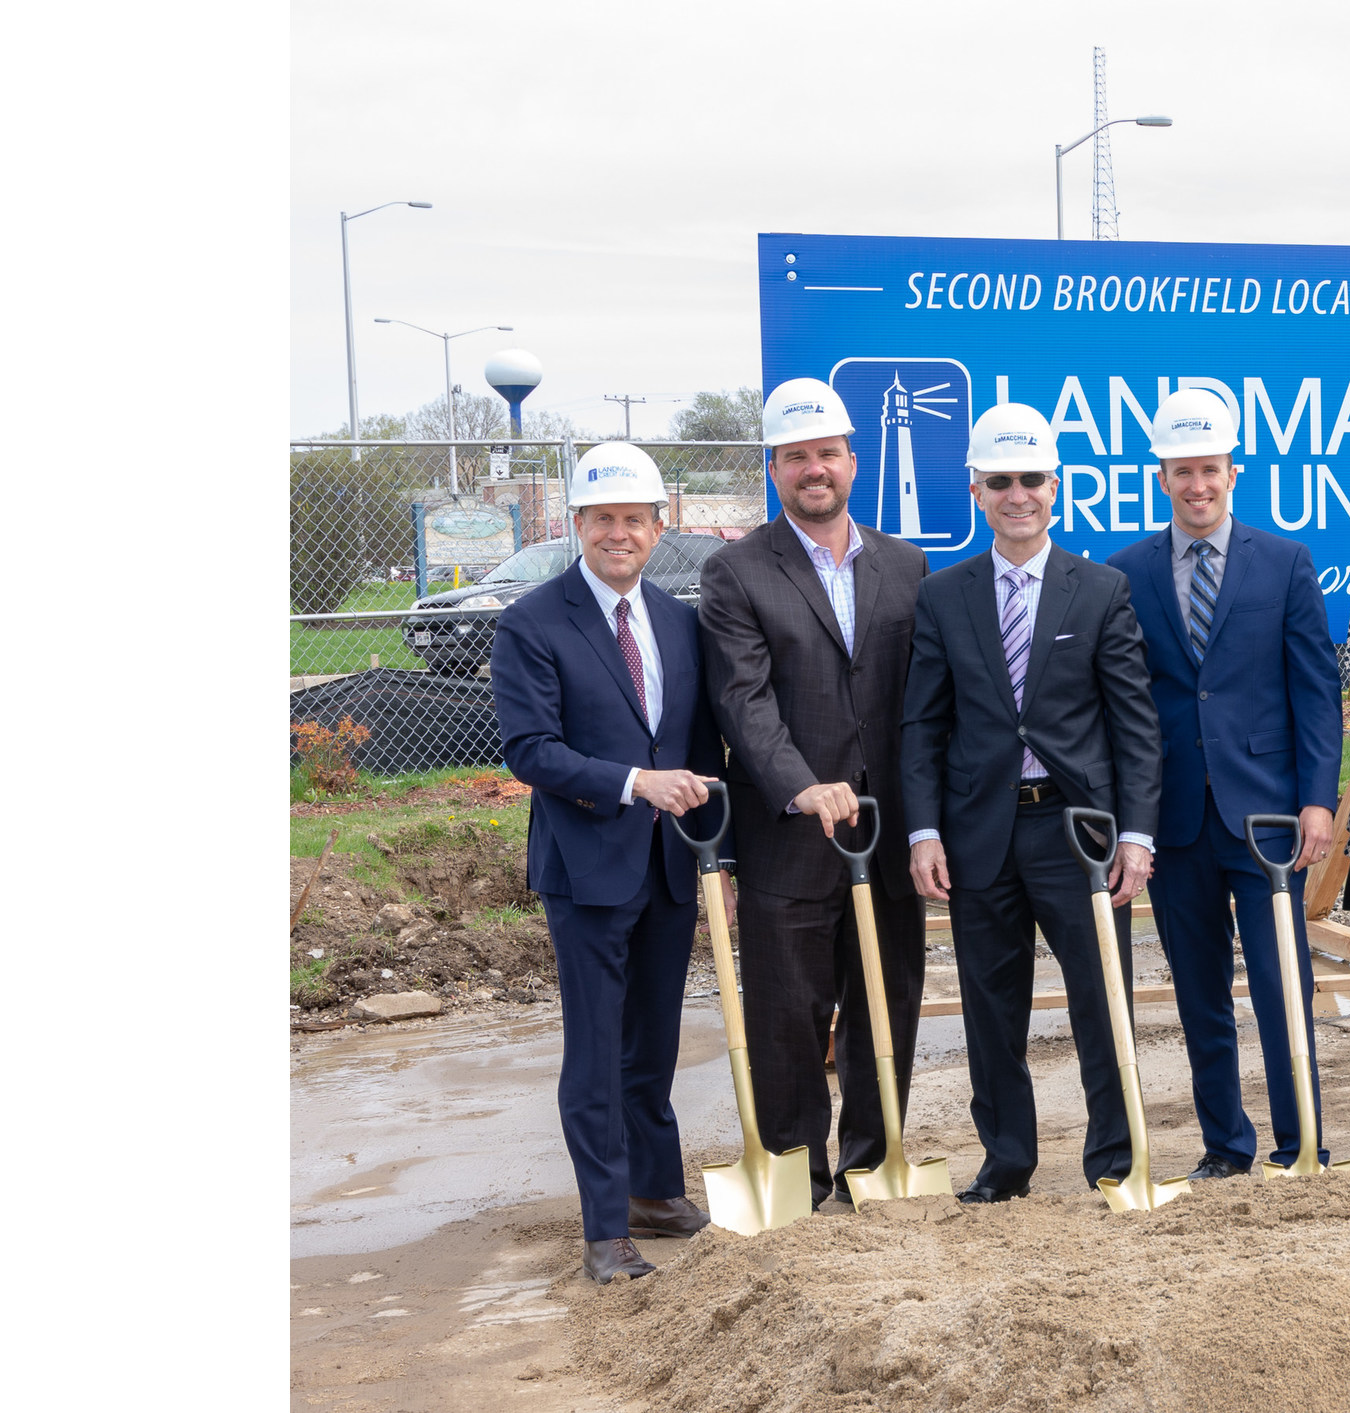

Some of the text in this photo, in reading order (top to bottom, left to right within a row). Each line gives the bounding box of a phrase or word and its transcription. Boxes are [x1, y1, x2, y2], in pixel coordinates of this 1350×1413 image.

[904, 272, 1042, 310] SECOND
[1053, 274, 1262, 314] BROOKFIELD
[782, 404, 814, 416] LaMACCHIA
[1171, 421, 1202, 430] LaMACCHIA
[994, 435, 1027, 443] LaMACCHIA
[598, 465, 633, 473] LANDMA
